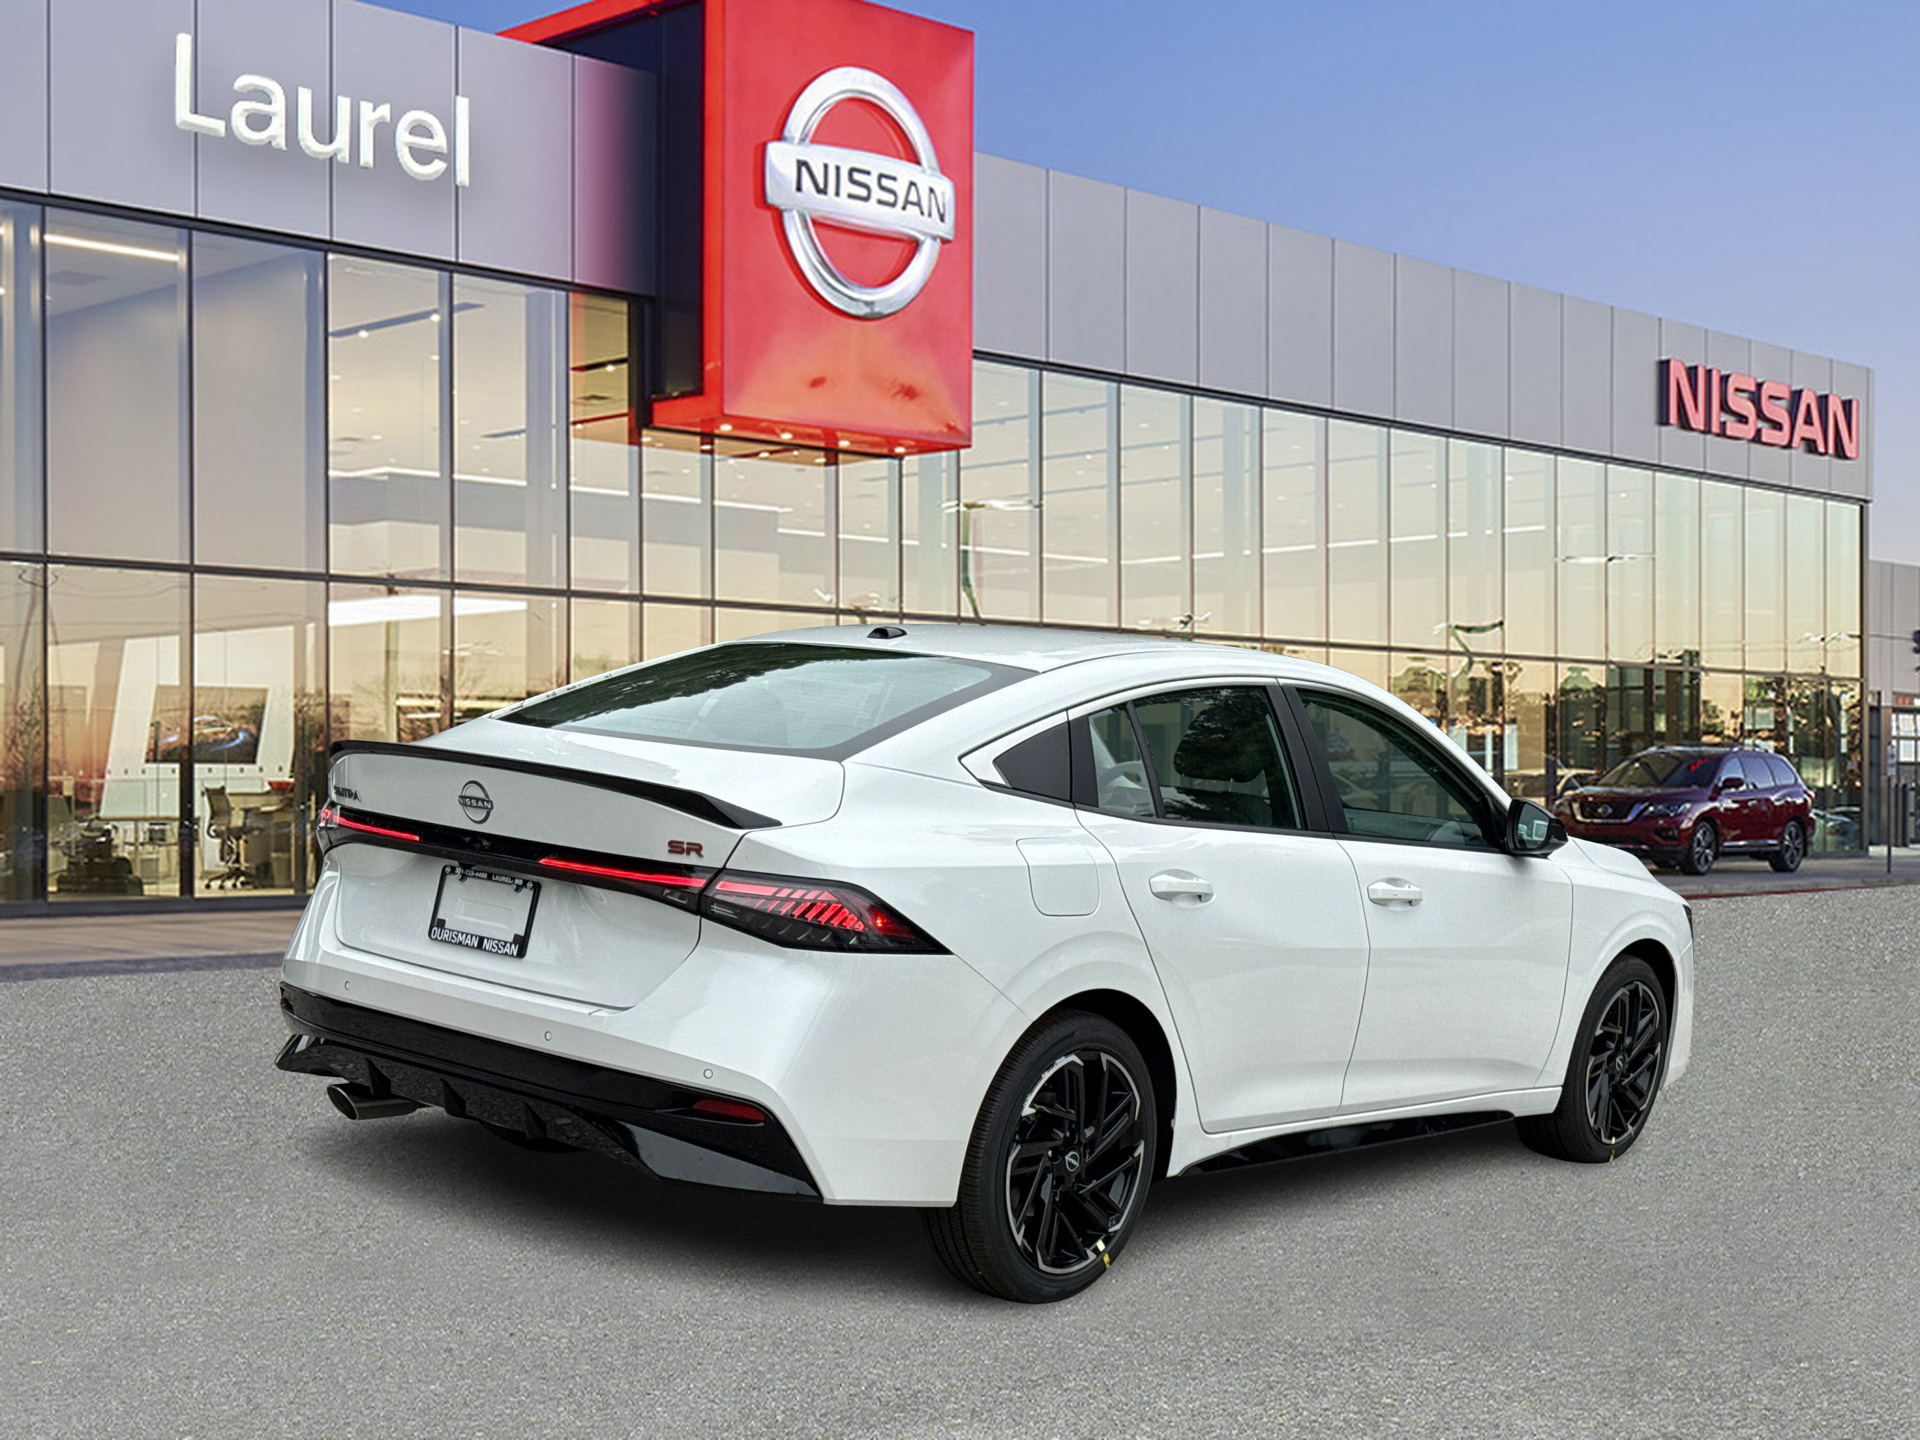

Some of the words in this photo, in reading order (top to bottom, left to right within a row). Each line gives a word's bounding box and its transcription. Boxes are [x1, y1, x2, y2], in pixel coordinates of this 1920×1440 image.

[174, 32, 470, 187] Laurel
[795, 158, 947, 224] NISSAN
[1658, 358, 1860, 460] NISSAN
[667, 839, 705, 859] SR
[430, 926, 480, 948] OURISMAN
[482, 937, 519, 957] NISSAN
